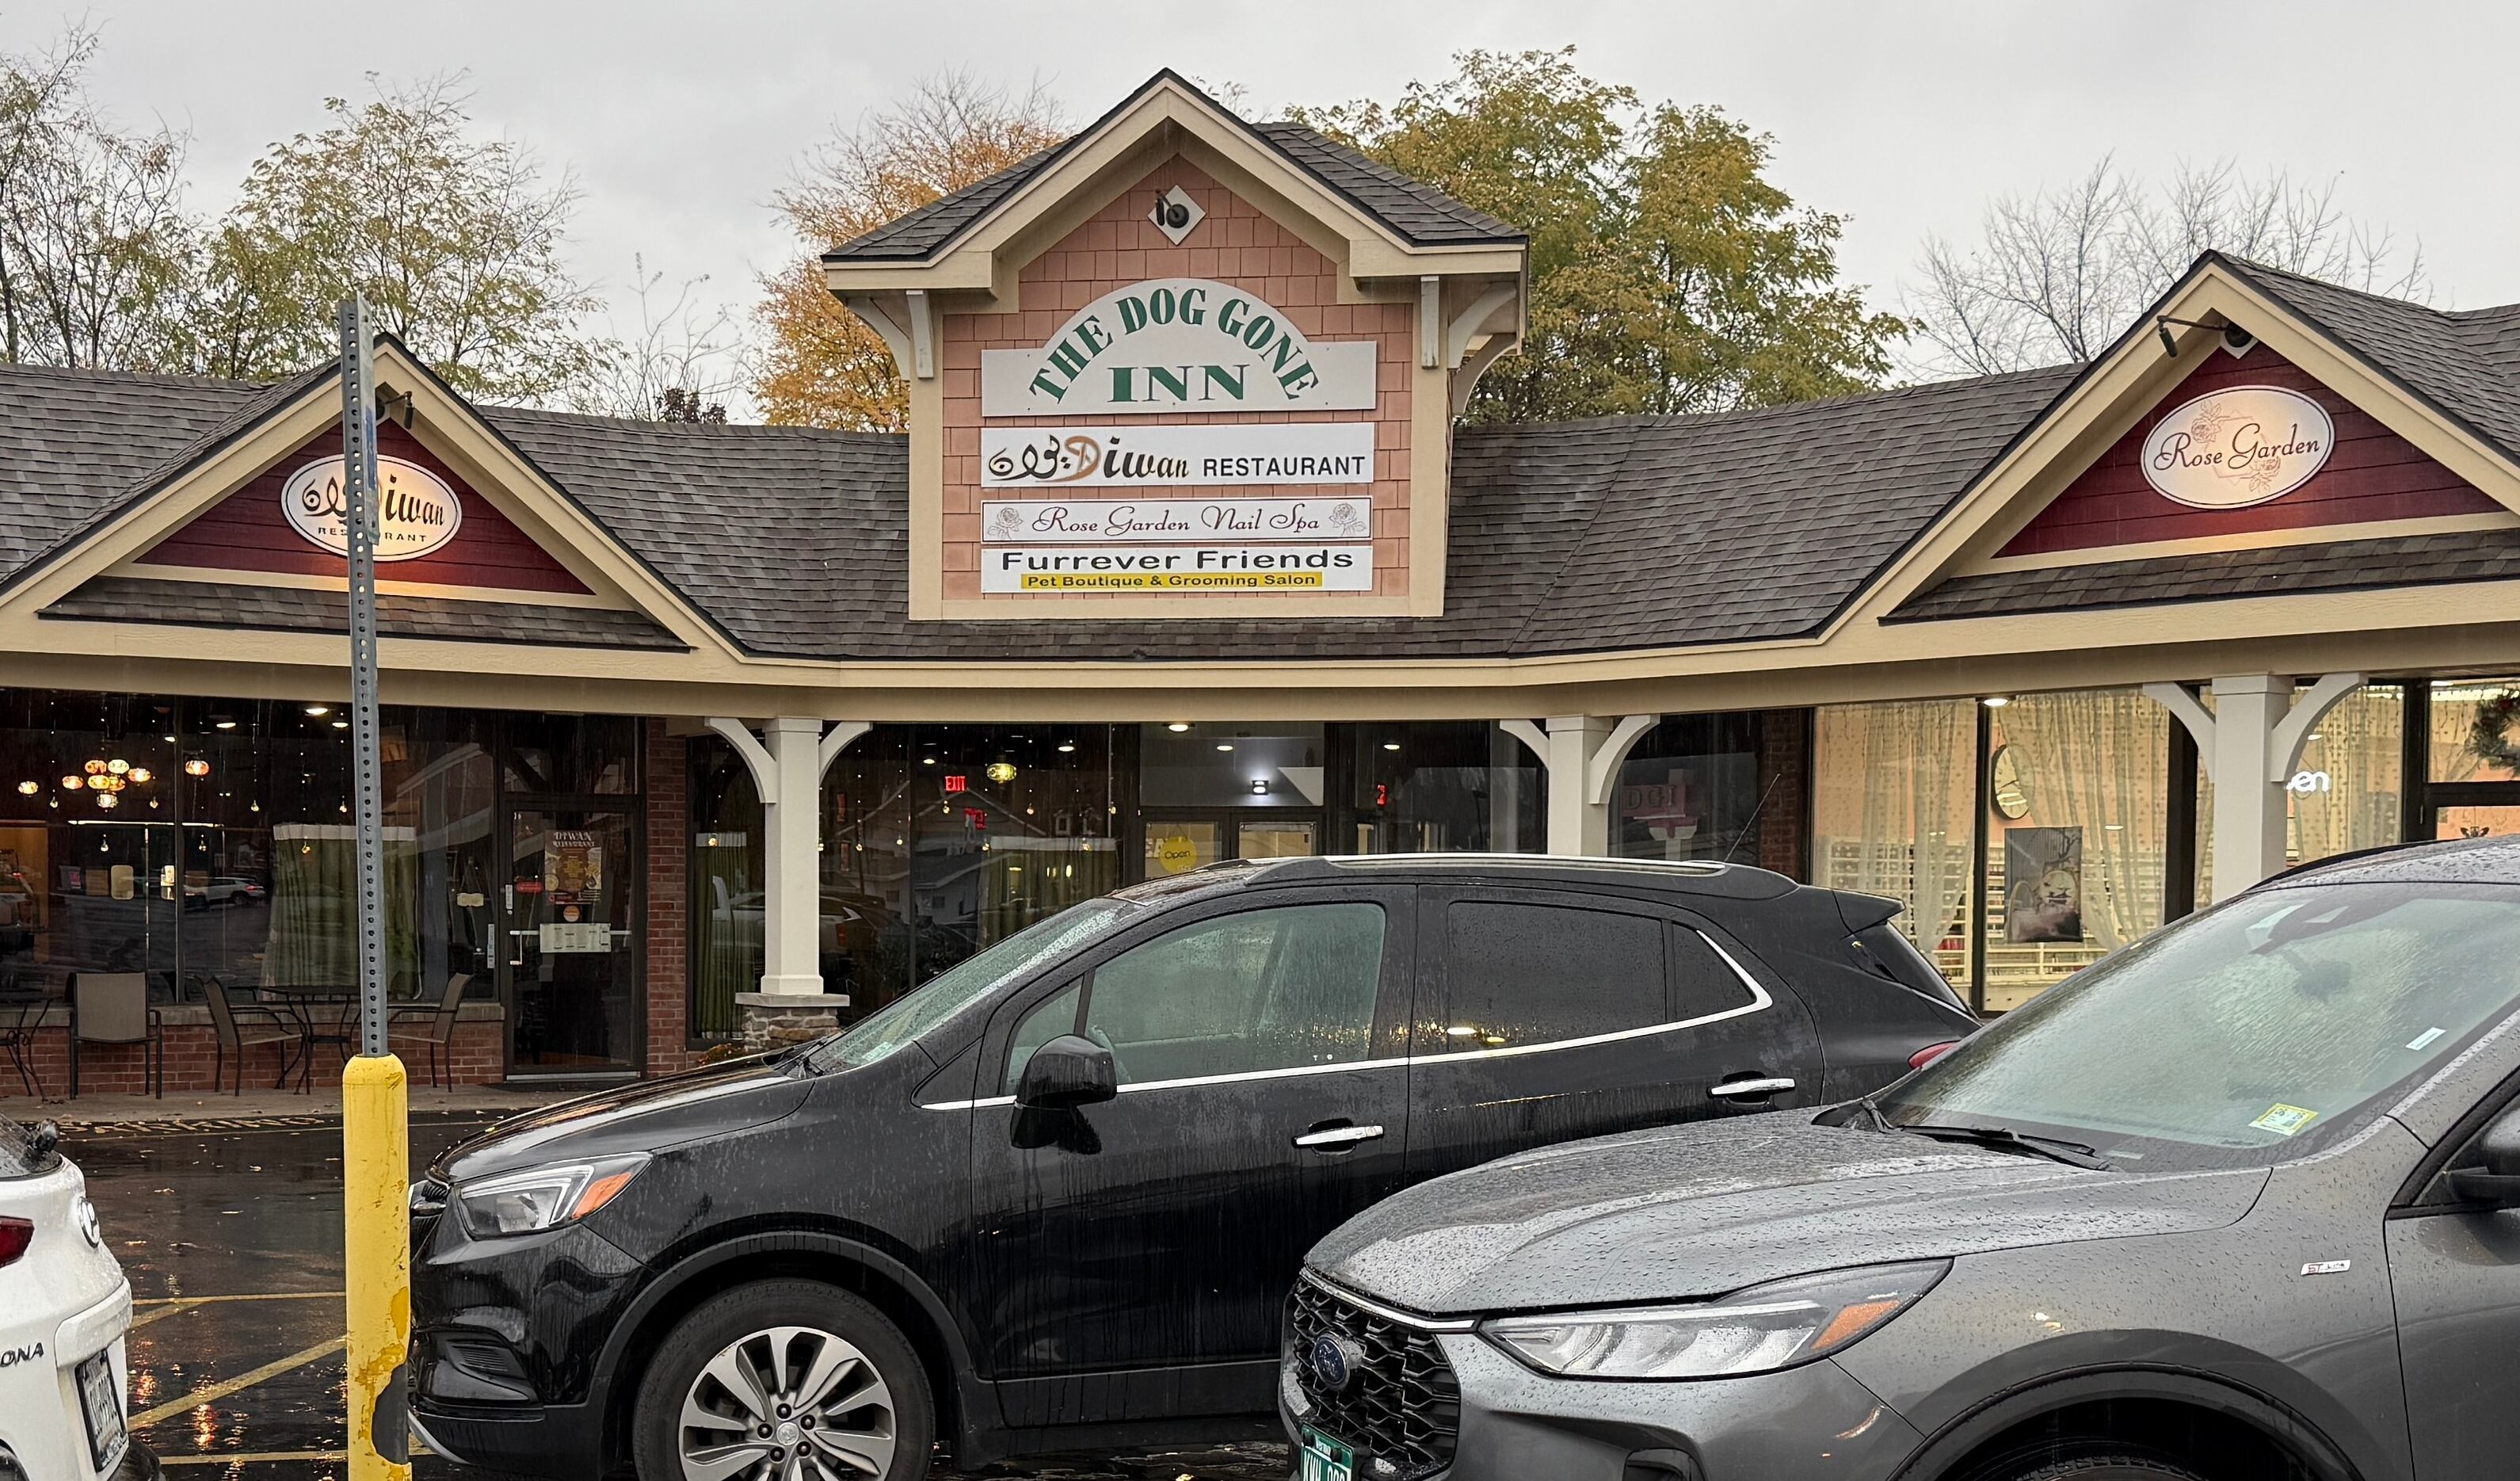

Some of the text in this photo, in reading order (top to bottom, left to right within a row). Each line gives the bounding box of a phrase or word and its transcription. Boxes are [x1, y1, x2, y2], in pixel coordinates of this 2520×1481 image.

[1029, 288, 1320, 404] THE DOG GONE
[1107, 364, 1250, 403] INN
[1035, 435, 1367, 483] Diwan RESTAURANT
[2153, 422, 2320, 471] Rose Garden
[377, 473, 444, 526] iwan
[1031, 502, 1321, 536] Rose Garden Nail Spa
[318, 526, 427, 543] RESRANT
[1002, 549, 1354, 571] Furrever Friends
[1027, 574, 1316, 589] Pet Boutique & Grooming Salon
[945, 776, 966, 791] EXIT
[1165, 850, 1191, 860] Open
[0, 1342, 44, 1368] ONA
